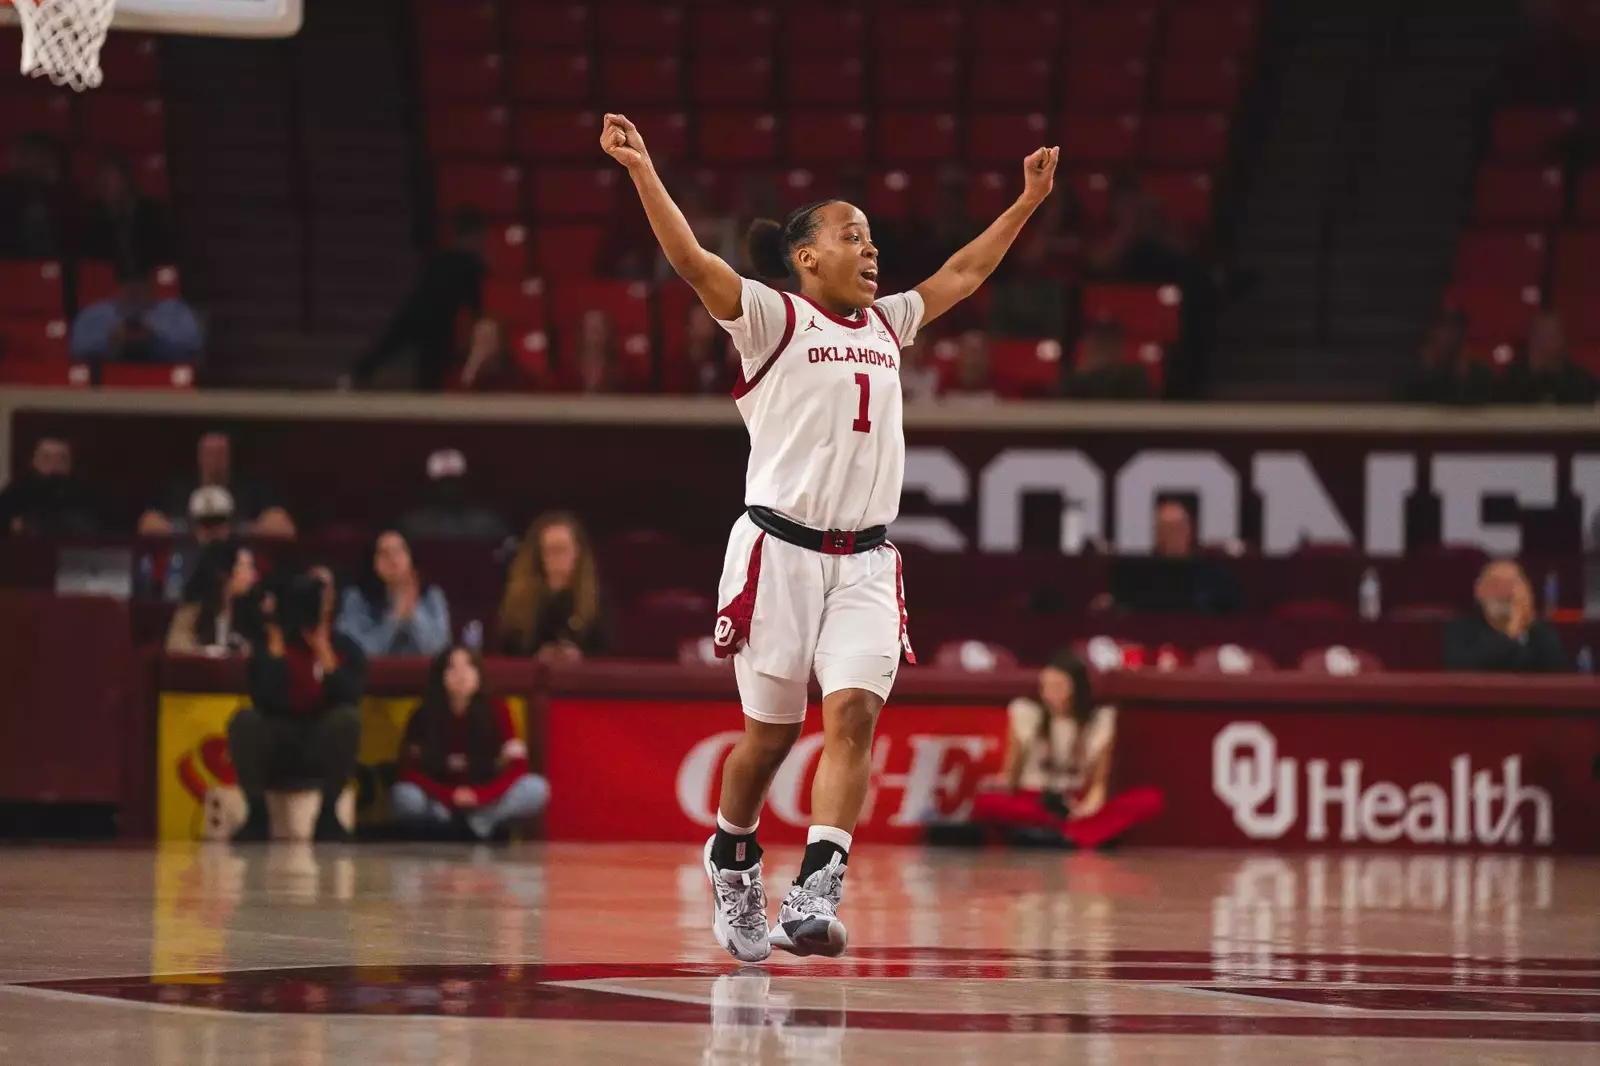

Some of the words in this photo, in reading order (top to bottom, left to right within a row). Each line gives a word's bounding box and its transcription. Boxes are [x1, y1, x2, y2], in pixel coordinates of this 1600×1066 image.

[808, 346, 898, 371] OKLAHOMA
[852, 372, 872, 434] 1
[888, 447, 1600, 556] OONE
[1212, 721, 1297, 840] OU
[1305, 753, 1555, 846] Health
